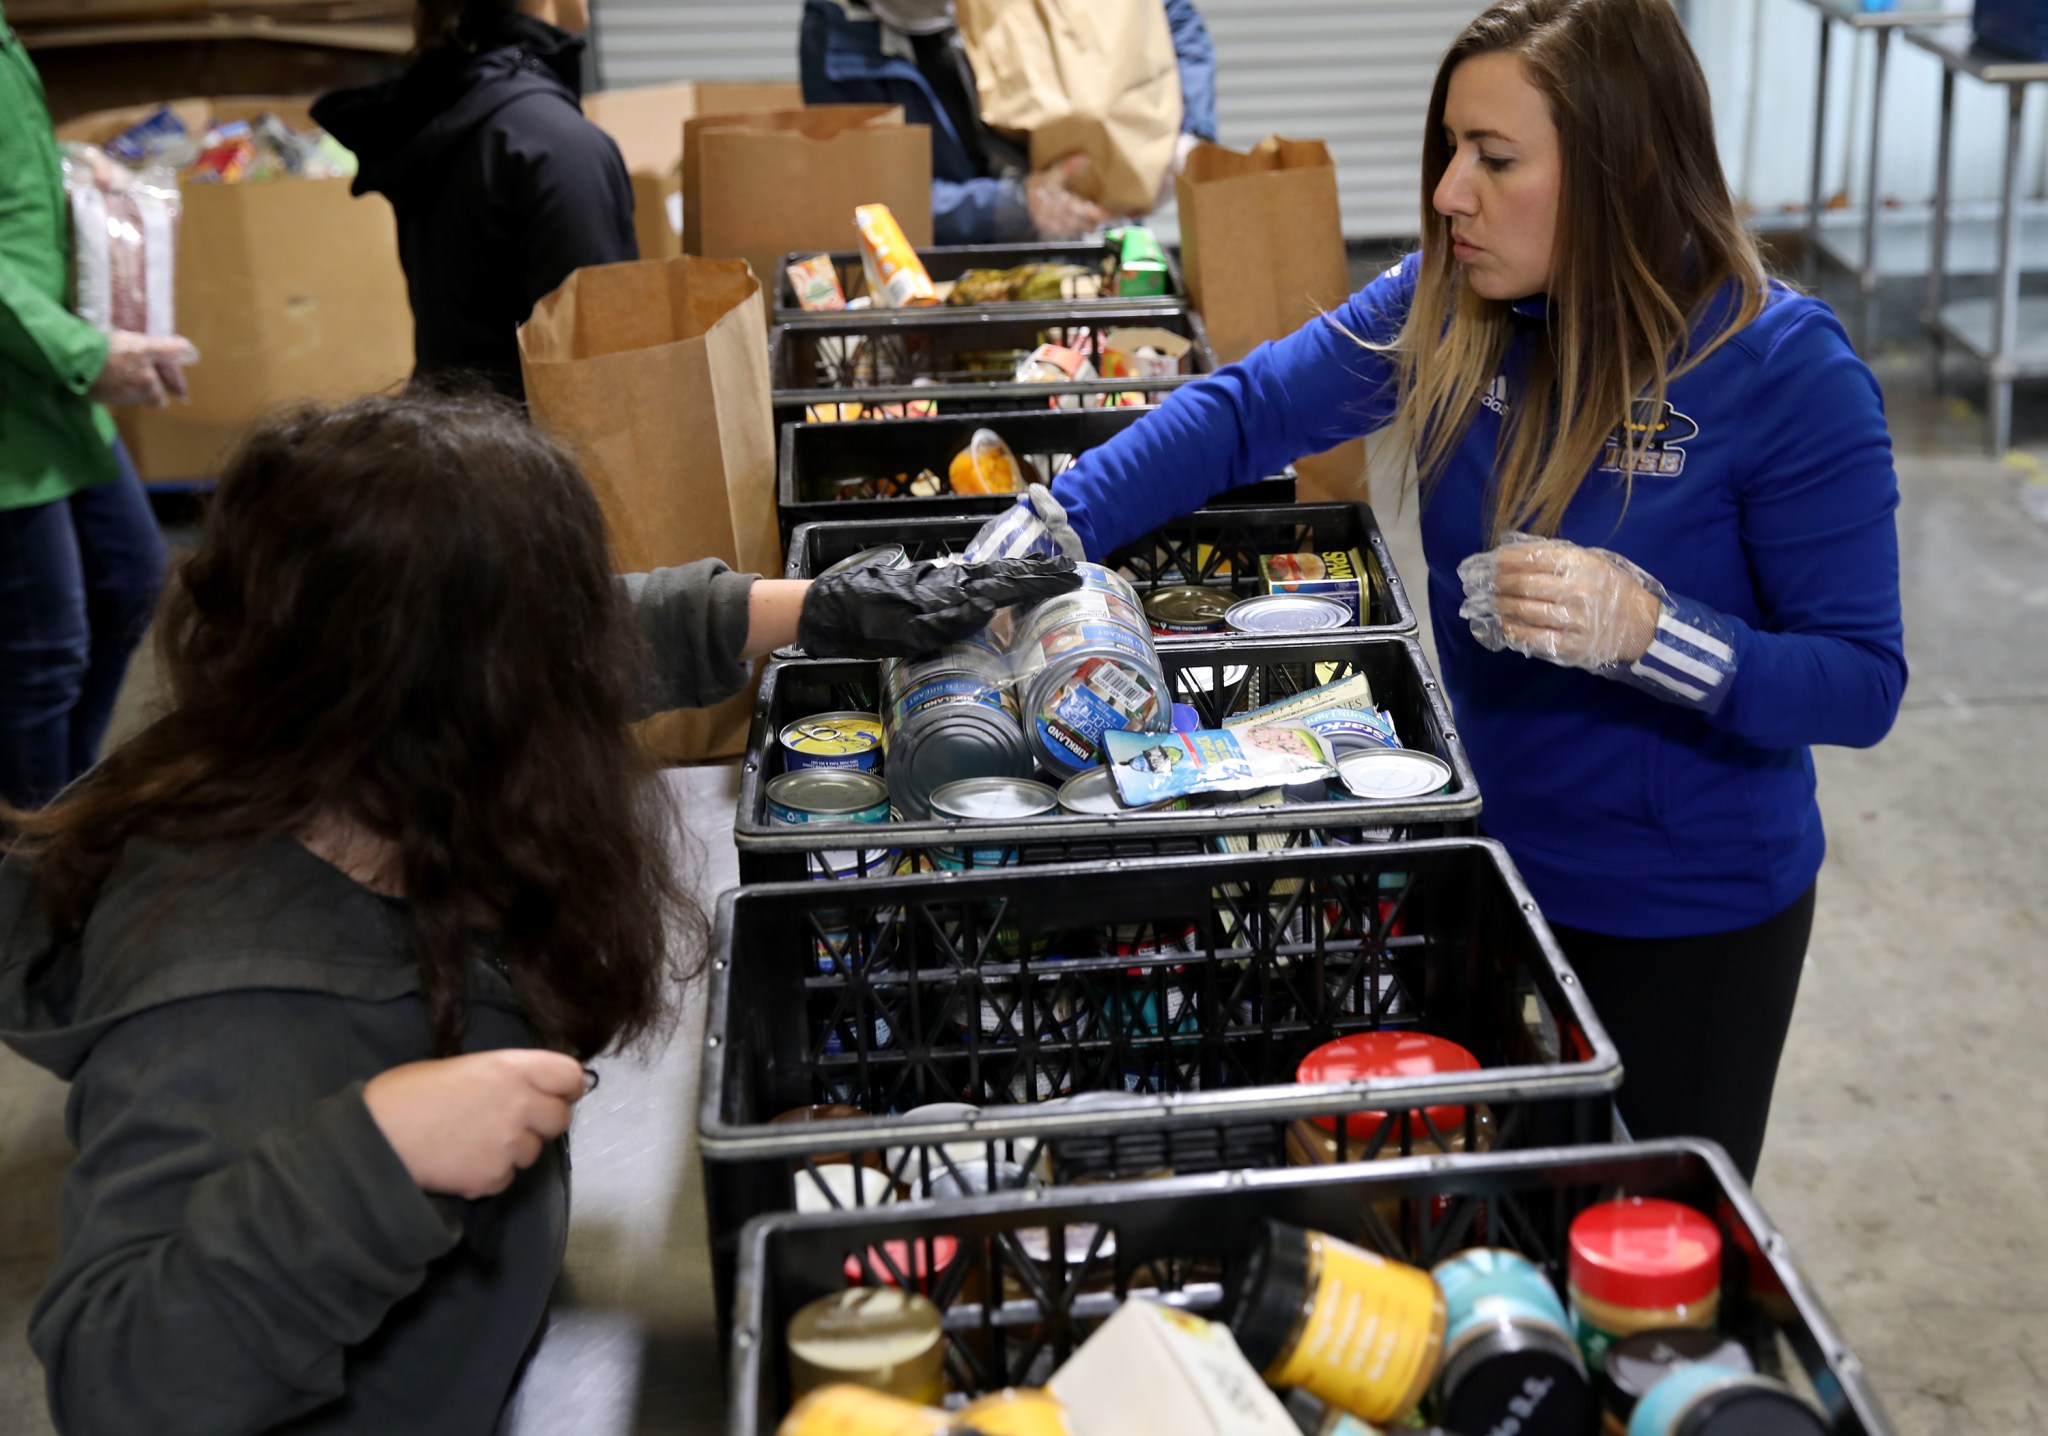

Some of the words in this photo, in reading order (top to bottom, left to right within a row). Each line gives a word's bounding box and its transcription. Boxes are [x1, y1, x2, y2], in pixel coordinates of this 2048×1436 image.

[1481, 395, 1510, 416] das
[1322, 551, 1354, 579] SPAM
[1047, 725, 1090, 761] KIRKLAND
